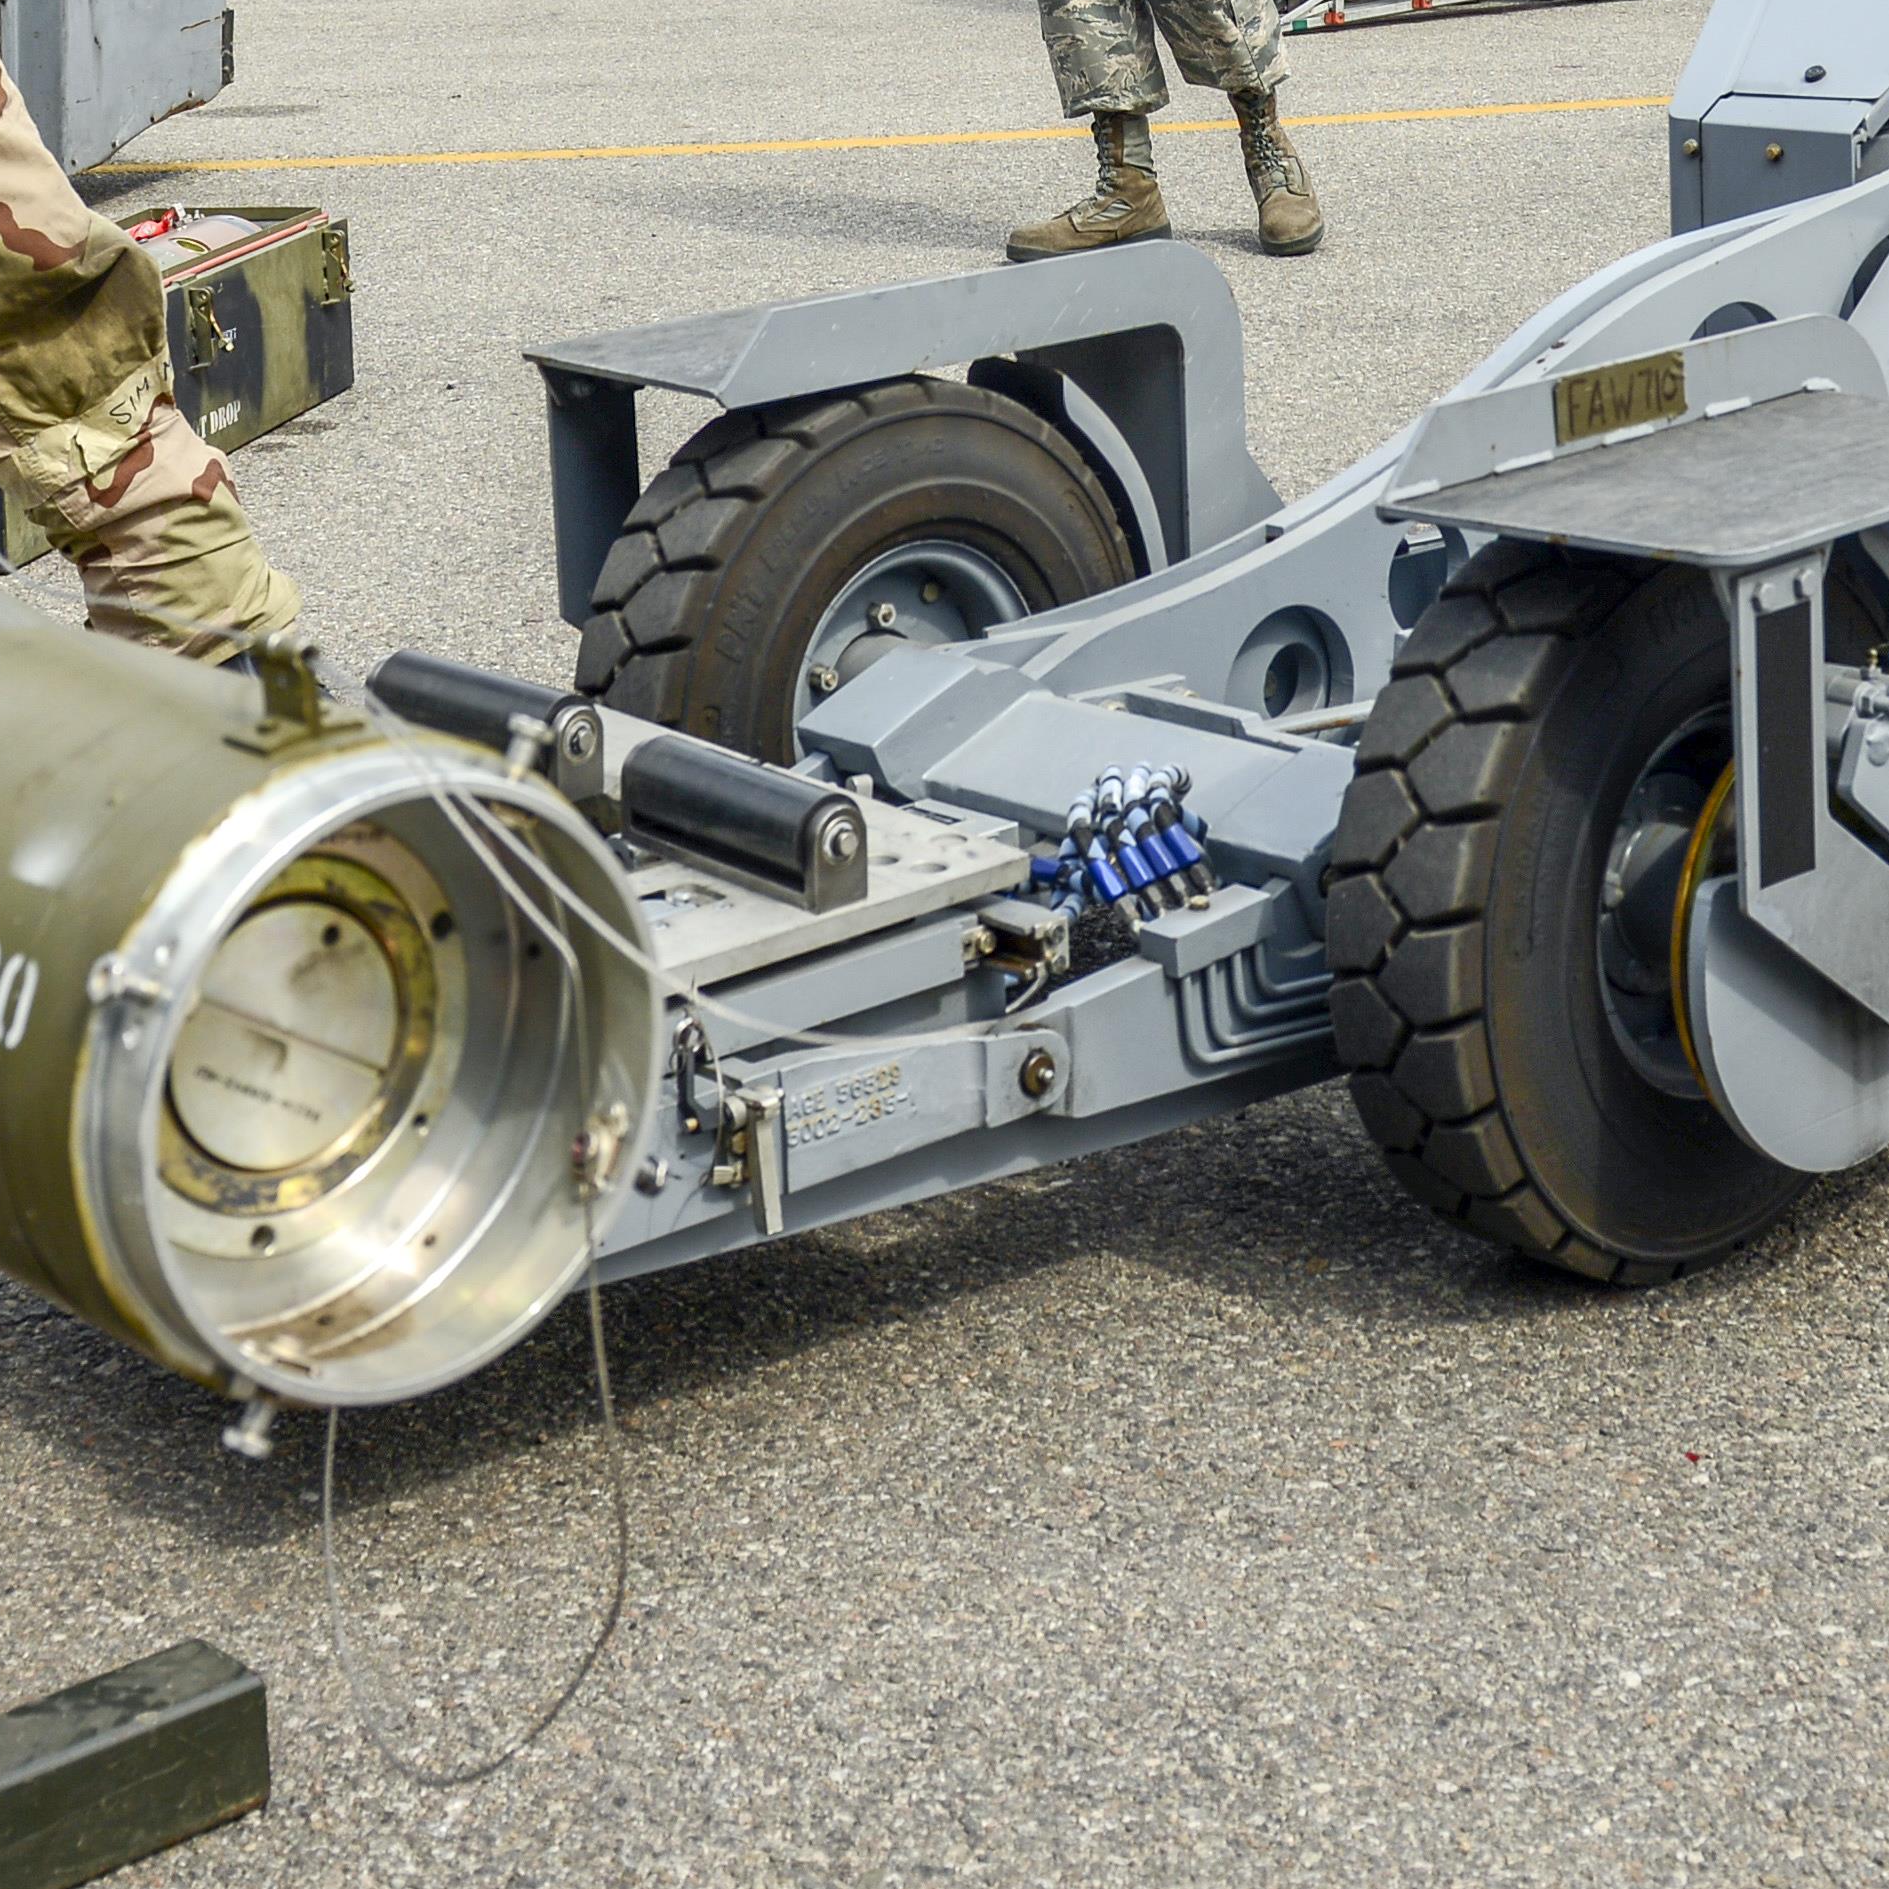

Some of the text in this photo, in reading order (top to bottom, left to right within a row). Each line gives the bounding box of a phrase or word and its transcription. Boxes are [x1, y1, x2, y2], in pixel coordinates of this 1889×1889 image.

[109, 376, 150, 425] SIM
[209, 399, 241, 435] DROP
[1567, 372, 1635, 437] FAW
